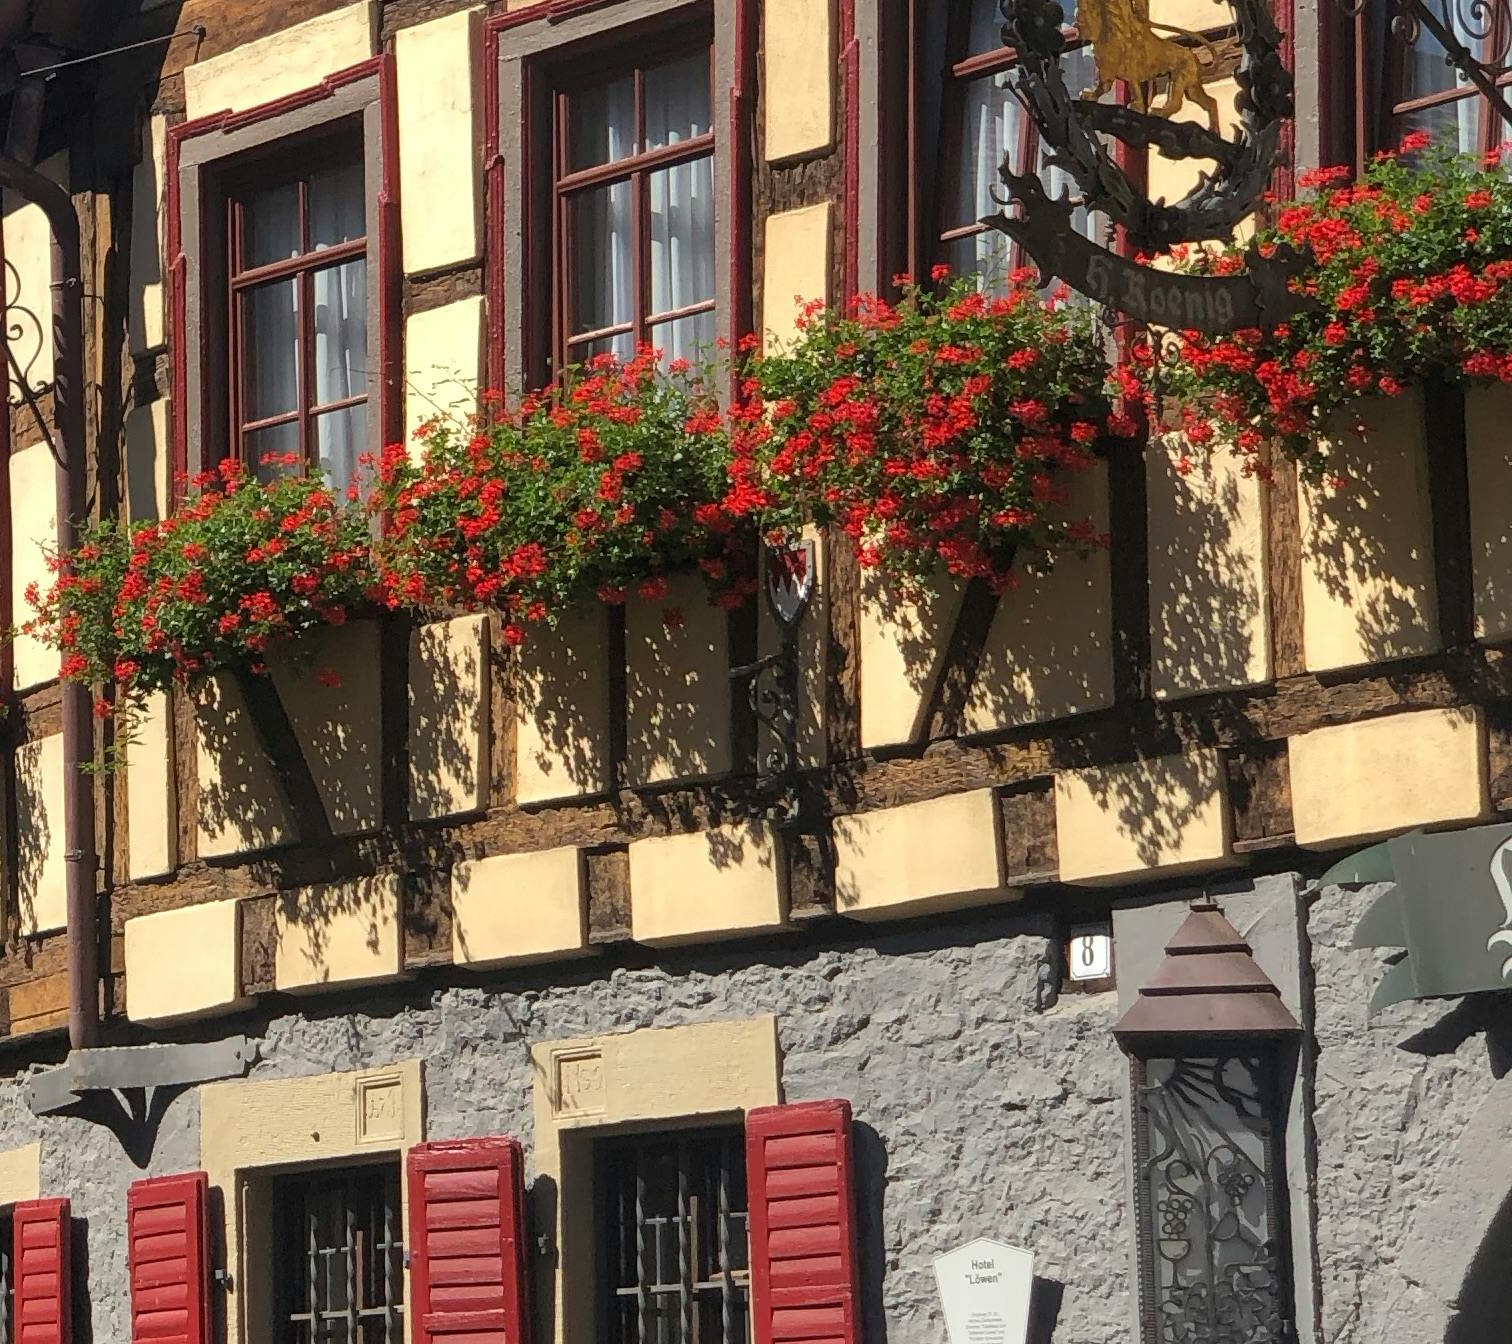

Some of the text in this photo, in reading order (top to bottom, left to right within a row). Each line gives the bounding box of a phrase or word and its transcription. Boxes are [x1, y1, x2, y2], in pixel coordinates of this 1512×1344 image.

[1082, 934, 1094, 966] 8
[971, 1259, 995, 1270] Hotel
[965, 1273, 1002, 1284] "Löwen"
